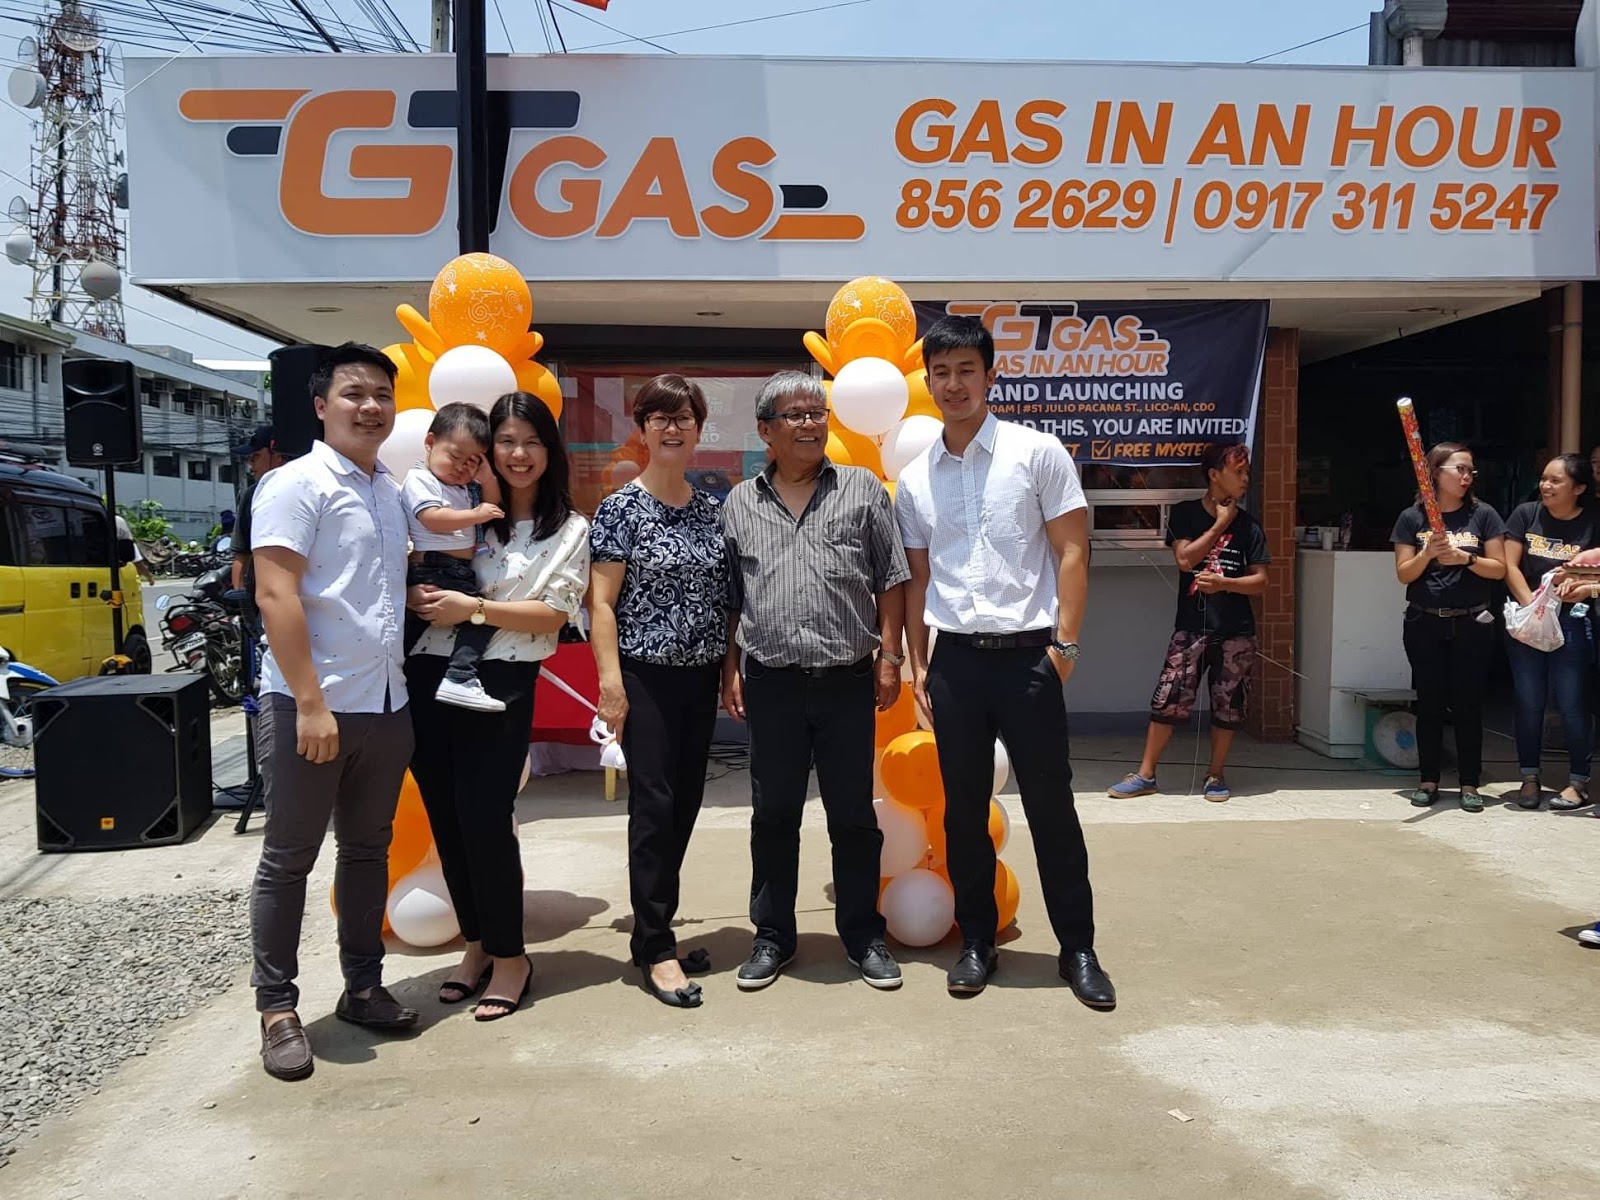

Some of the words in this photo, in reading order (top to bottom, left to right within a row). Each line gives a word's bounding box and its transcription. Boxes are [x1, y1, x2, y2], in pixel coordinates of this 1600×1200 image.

[895, 98, 1067, 167] GAS
[1086, 100, 1174, 166] IN
[1187, 102, 1311, 168] AN
[1330, 104, 1562, 169] HOUR
[508, 135, 778, 240] GAS
[895, 178, 1001, 230] 856
[1013, 178, 1157, 230] 2629
[1193, 180, 1325, 231] 0917
[1332, 182, 1411, 231] 311
[1429, 182, 1559, 232] 5247
[1051, 317, 1139, 352] GAS
[993, 353, 1026, 375] AS
[1028, 353, 1056, 375] IN
[1056, 353, 1094, 374] AN
[1096, 352, 1166, 374] HOUR
[985, 383, 1040, 402] AND
[1045, 381, 1184, 401] LAUNCHING
[1022, 403, 1043, 414] #51
[1045, 403, 1076, 413] JULIO
[1078, 402, 1123, 413] PACANA
[1144, 402, 1191, 413] LICO-AN,
[1193, 402, 1216, 412] CDO
[1040, 418, 1089, 437] THIS,
[1091, 418, 1133, 436] YOU
[1135, 417, 1174, 435] ARE
[1176, 417, 1250, 435] INVITED!
[1113, 442, 1152, 458] FREE
